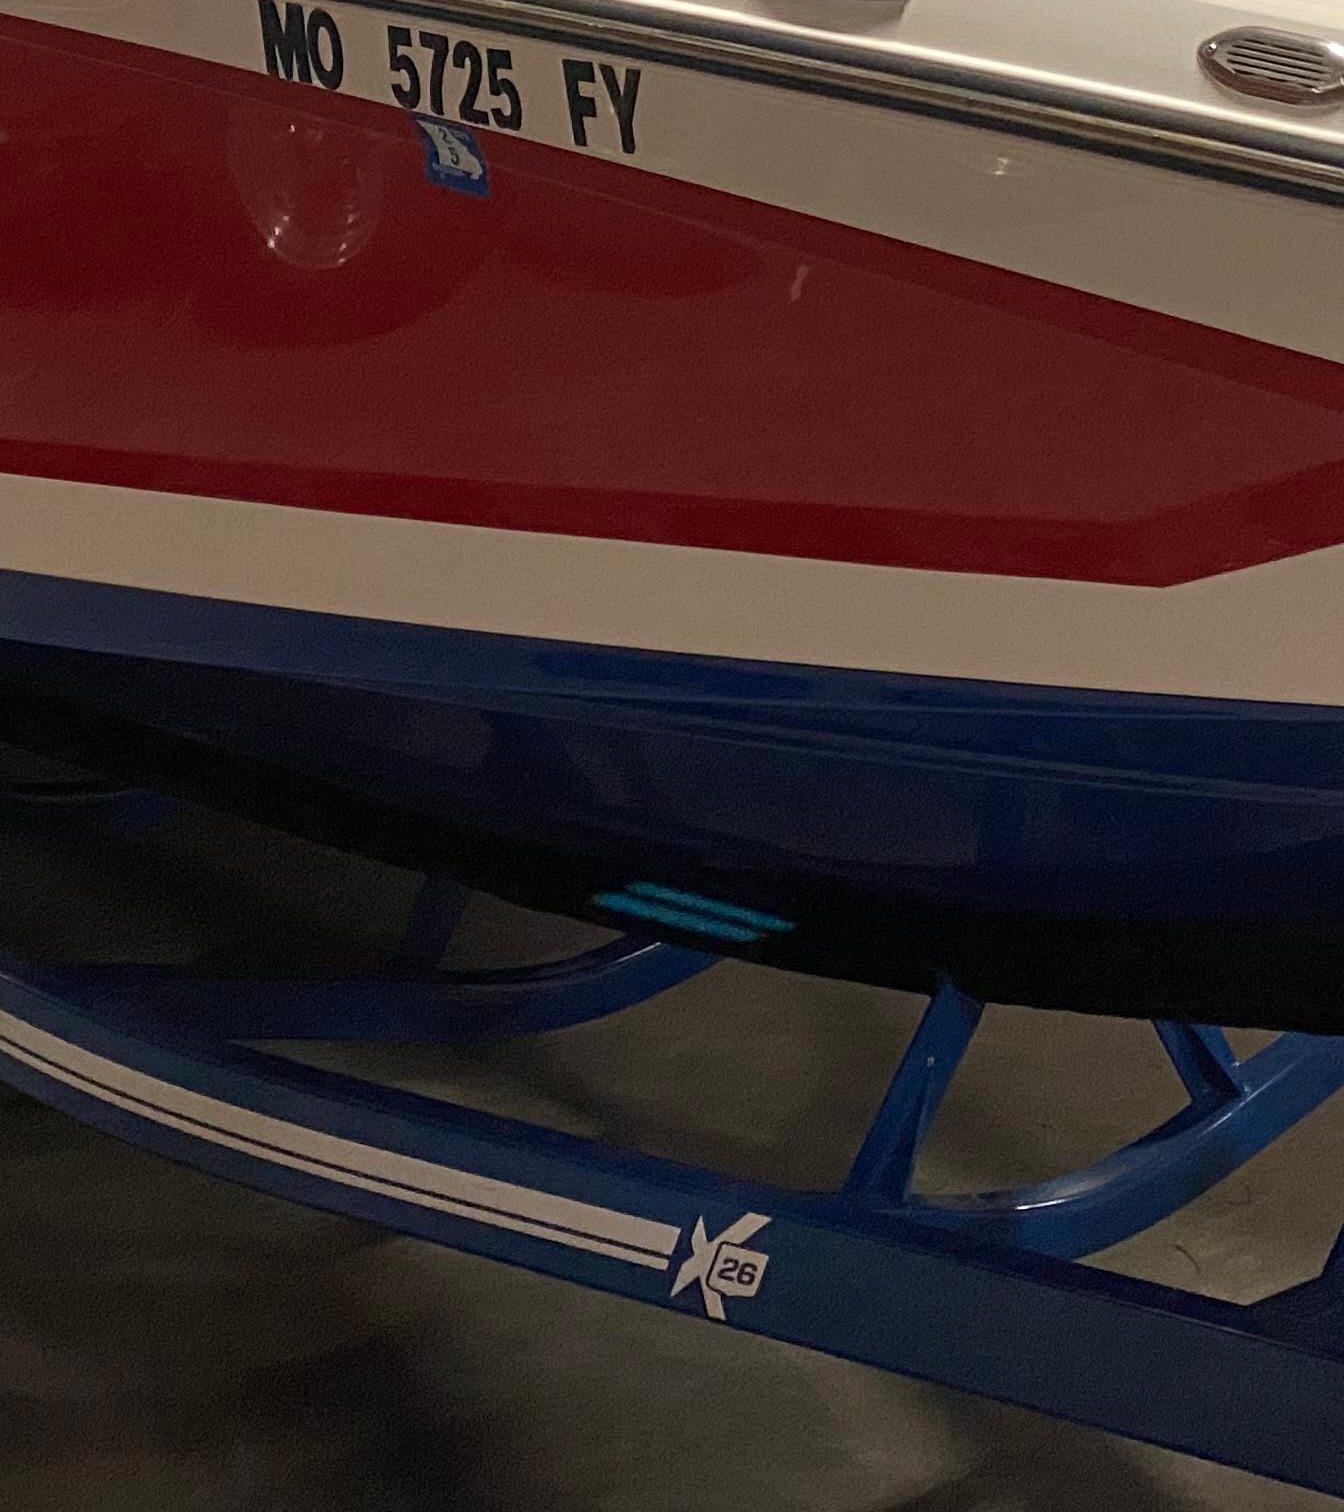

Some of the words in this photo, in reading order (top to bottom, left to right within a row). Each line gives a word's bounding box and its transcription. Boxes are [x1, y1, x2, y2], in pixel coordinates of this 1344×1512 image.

[387, 25, 522, 131] 5725
[562, 58, 642, 155] FY
[717, 1258, 758, 1286] 26
